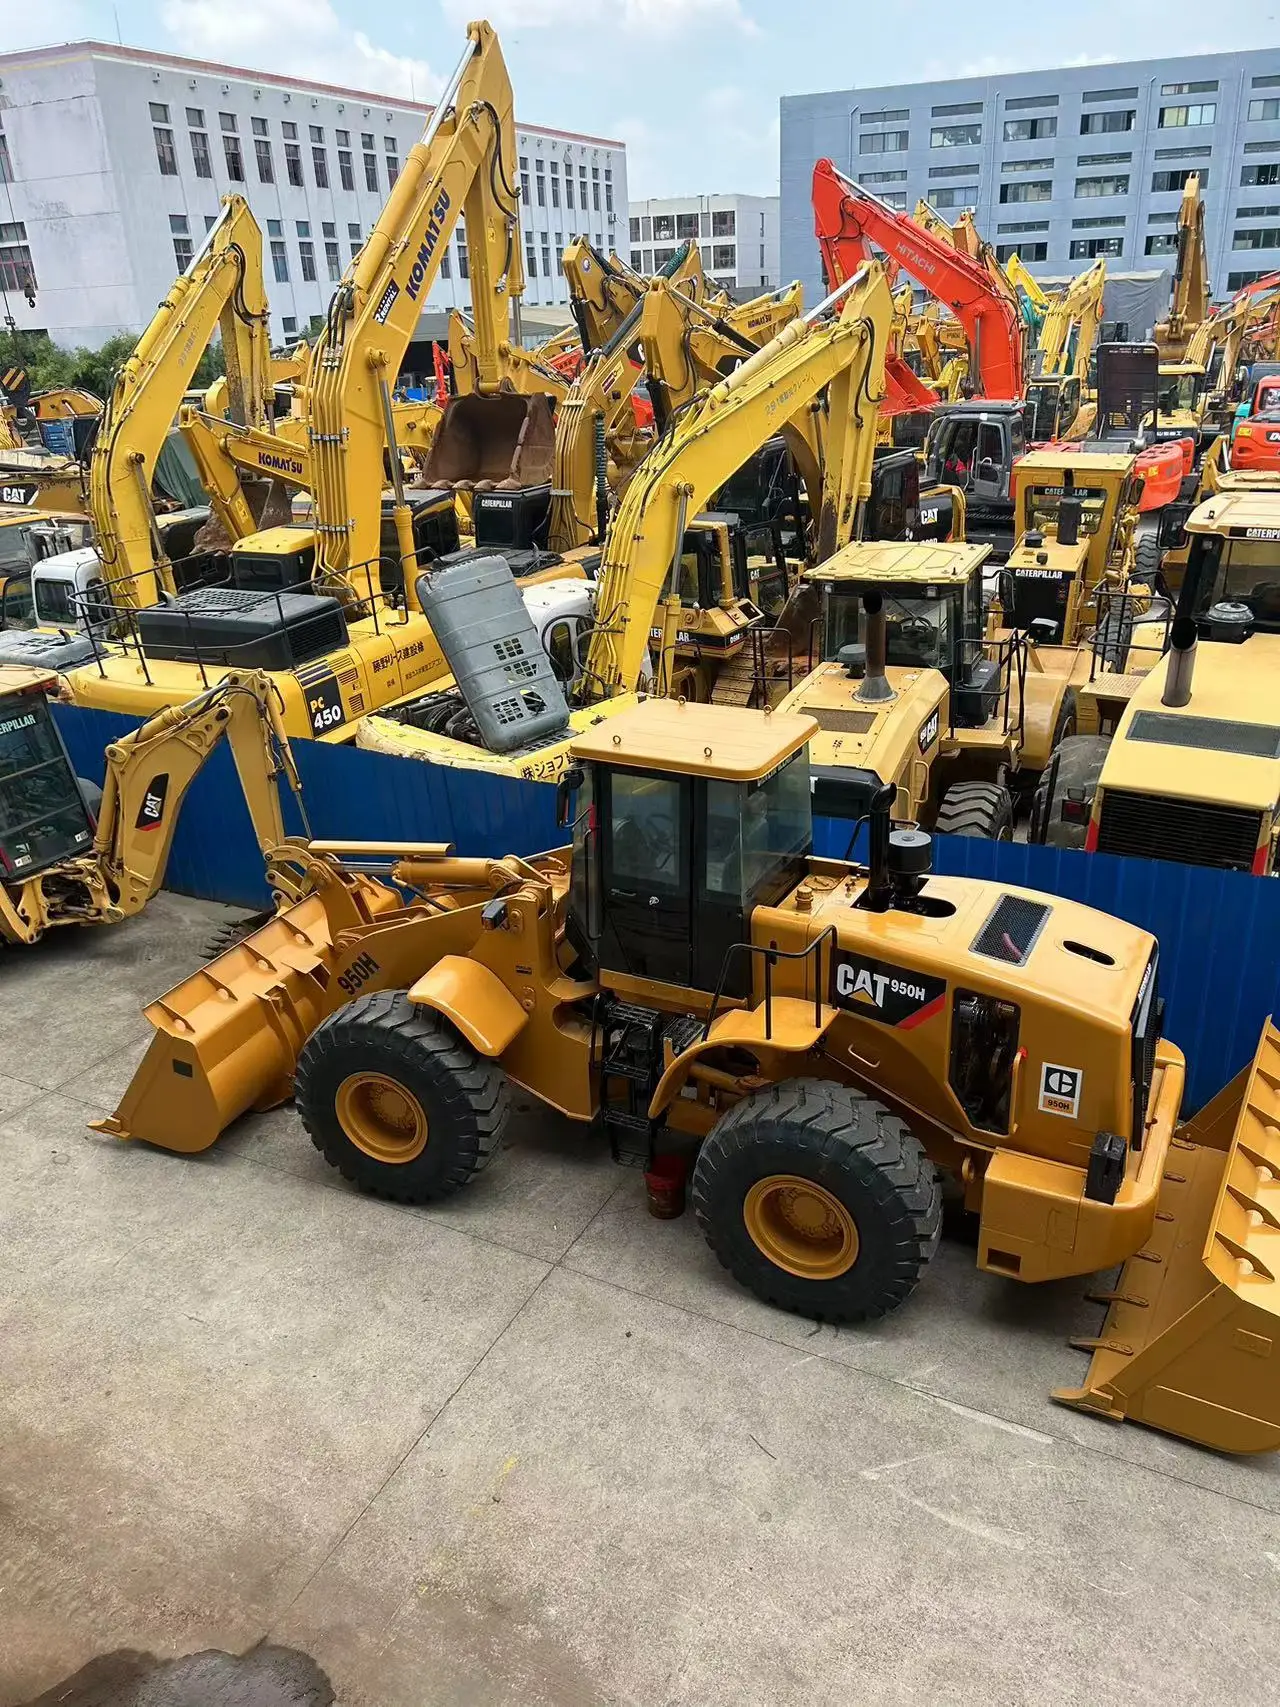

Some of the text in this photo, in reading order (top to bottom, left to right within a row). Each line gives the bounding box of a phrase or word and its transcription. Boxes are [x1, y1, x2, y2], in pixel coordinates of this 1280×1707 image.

[405, 187, 450, 301] KOMATSU
[894, 241, 936, 275] HITACHI
[258, 452, 303, 474] KOMATSU
[3, 487, 25, 503] CAT
[481, 499, 513, 508] CATERPILLAR
[920, 508, 938, 525] CAT
[1015, 569, 1063, 579] CATERPILLAR
[310, 697, 325, 713] PC
[314, 705, 341, 728] 450
[144, 793, 162, 817] CAT
[337, 952, 380, 995] 950H
[837, 964, 926, 1007] CAT 950H
[1047, 1099, 1070, 1110] 950H
